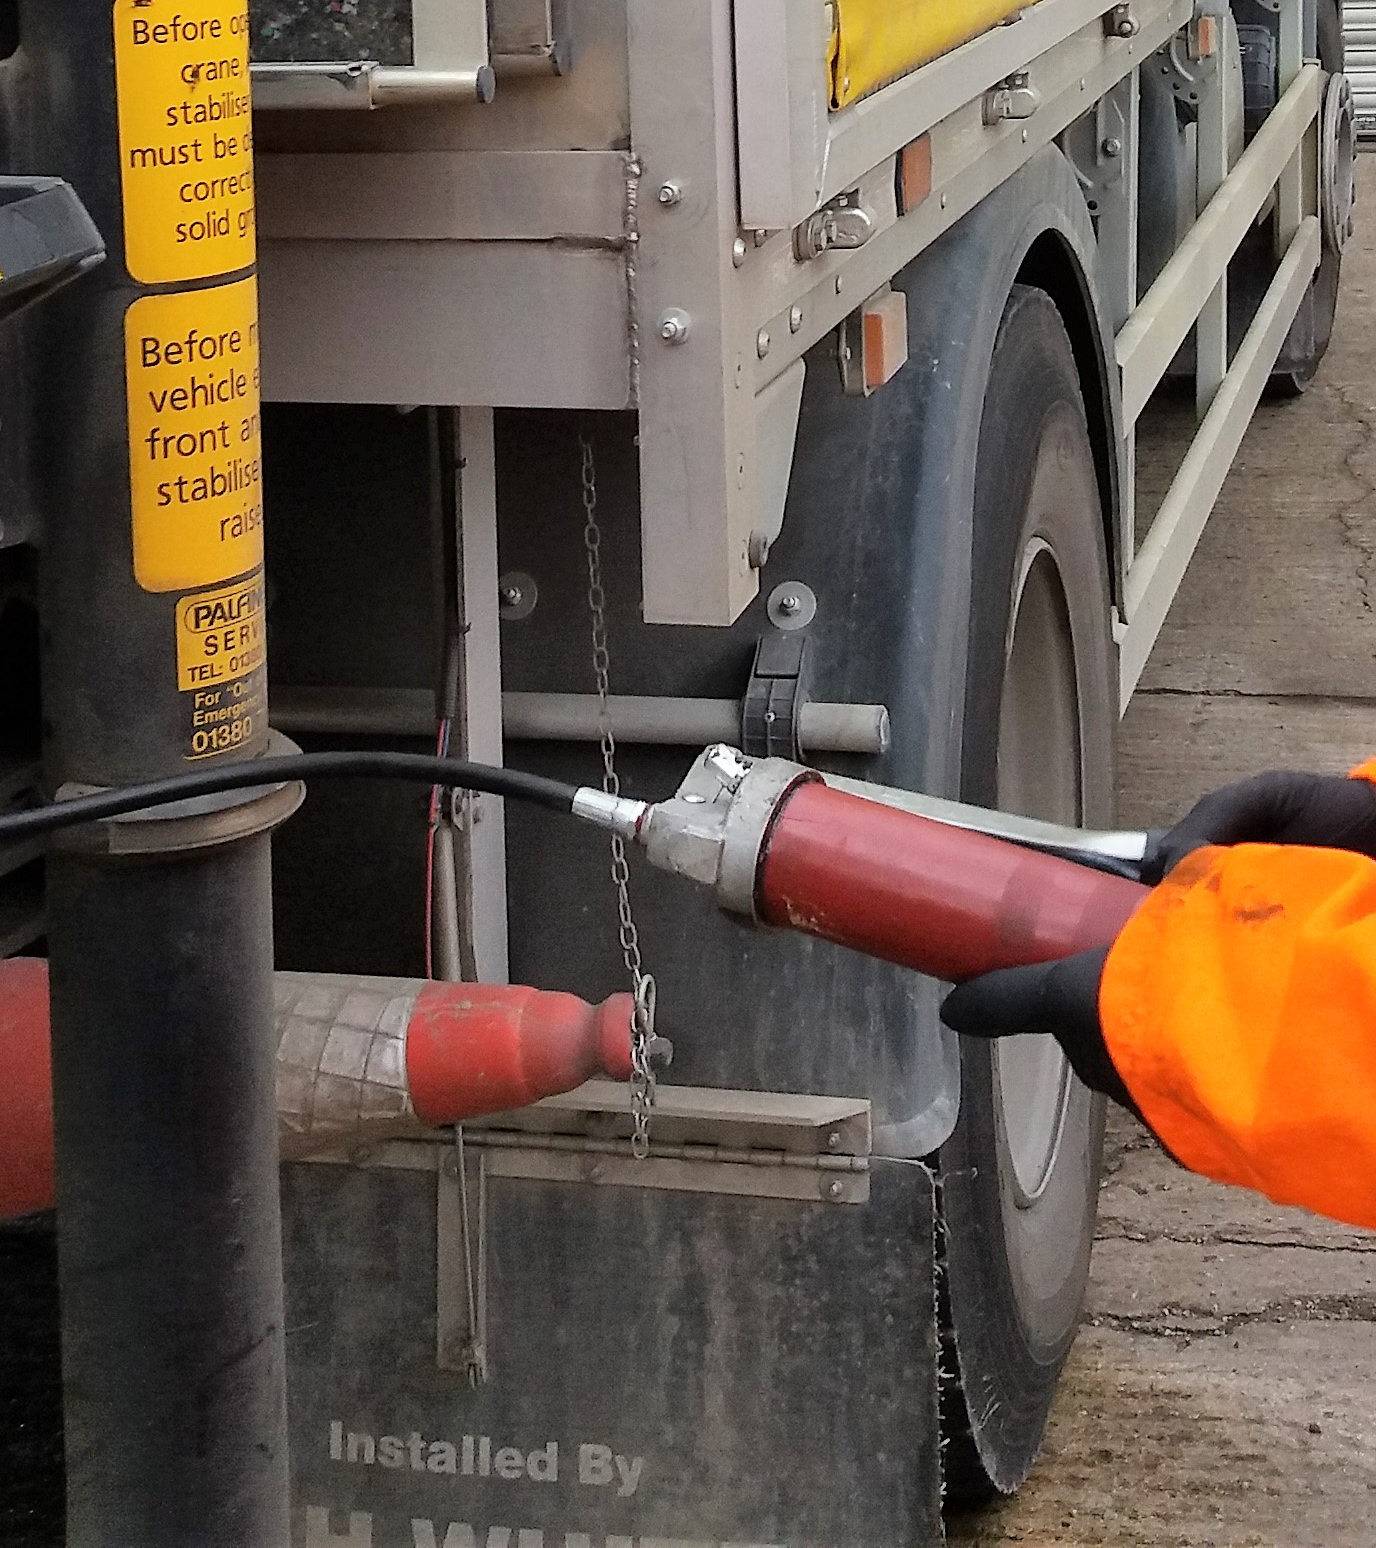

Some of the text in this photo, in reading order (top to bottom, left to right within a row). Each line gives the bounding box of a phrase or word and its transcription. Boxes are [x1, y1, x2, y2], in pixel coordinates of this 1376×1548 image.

[132, 14, 222, 45] Before
[166, 91, 250, 127] stabilise
[130, 139, 203, 168] must
[213, 132, 237, 159] be
[175, 208, 230, 244] solid
[140, 329, 242, 368] Before
[148, 367, 247, 414] vehicle
[144, 413, 258, 461] front an
[157, 456, 259, 507] stabilise
[187, 662, 224, 683] TEL:
[194, 692, 221, 710] For
[192, 715, 253, 753] 01380
[328, 1419, 646, 1497] Installed By
